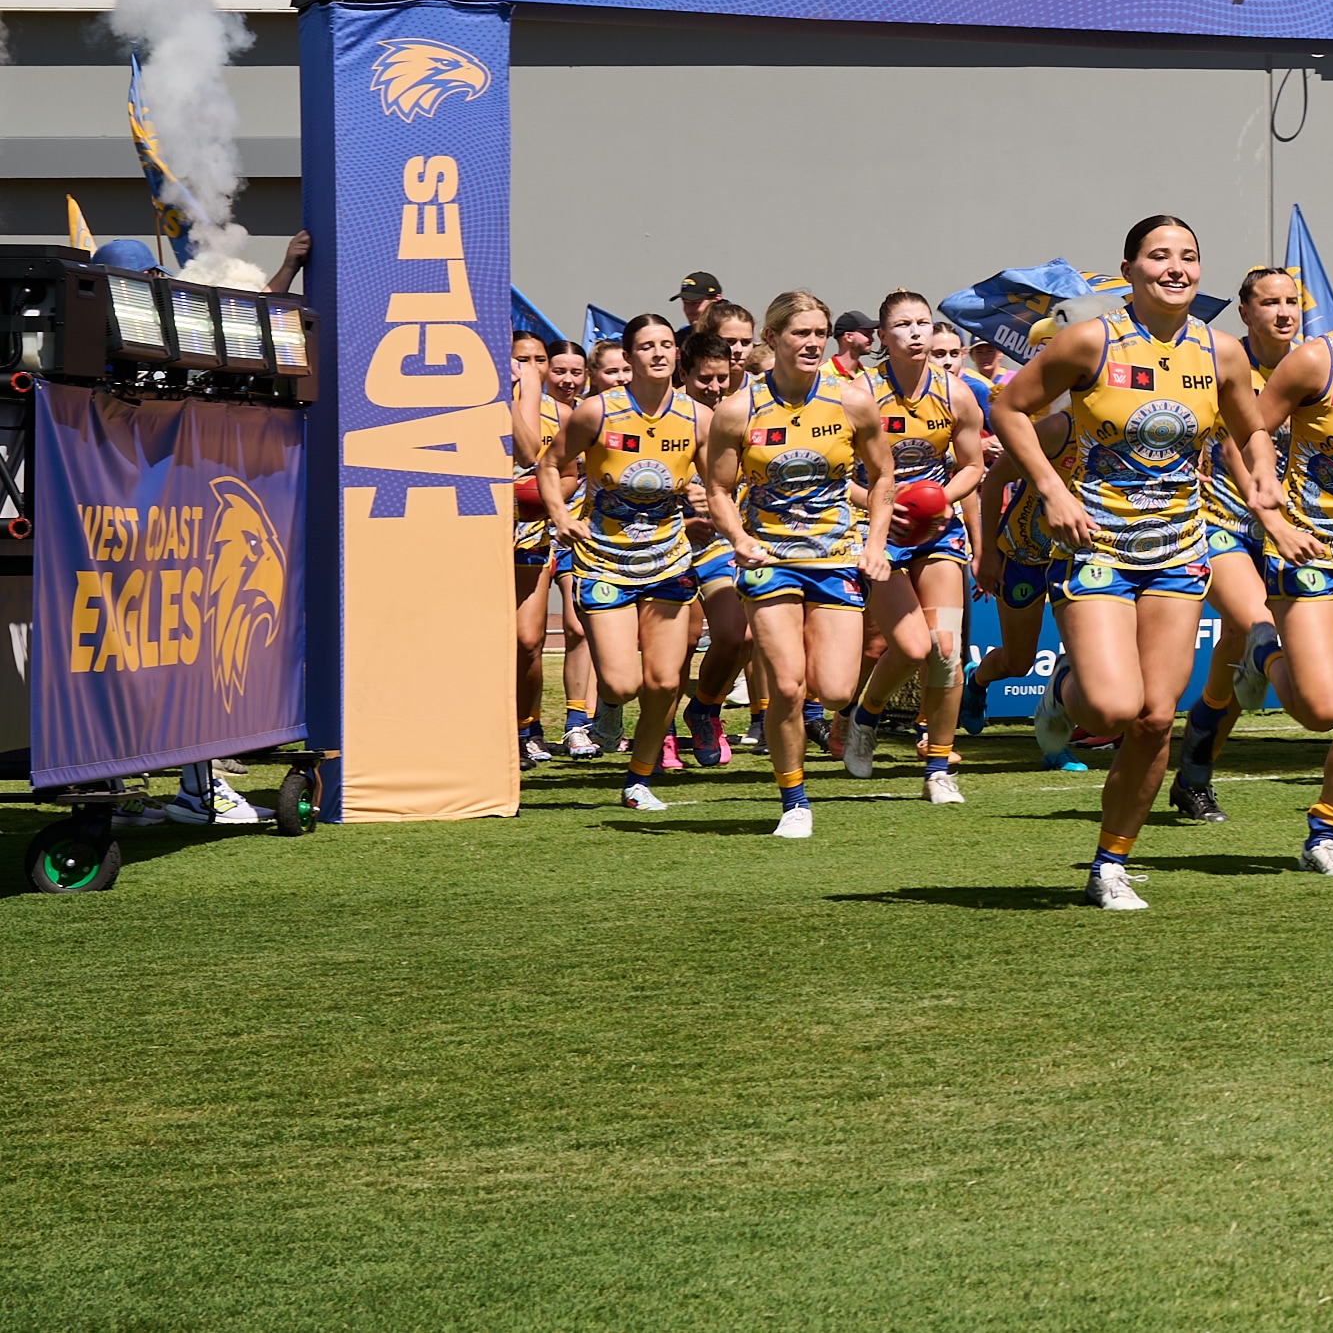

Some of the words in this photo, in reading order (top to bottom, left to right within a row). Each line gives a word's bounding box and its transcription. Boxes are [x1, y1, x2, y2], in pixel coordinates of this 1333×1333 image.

[343, 155, 513, 534] EAGLES
[1182, 375, 1213, 390] BHP
[812, 423, 842, 438] BHP
[927, 419, 952, 430] BHP
[542, 435, 553, 446] HP
[661, 439, 690, 452] BHP
[70, 567, 204, 673] EAGLES
[1004, 685, 1046, 696] FOUND
